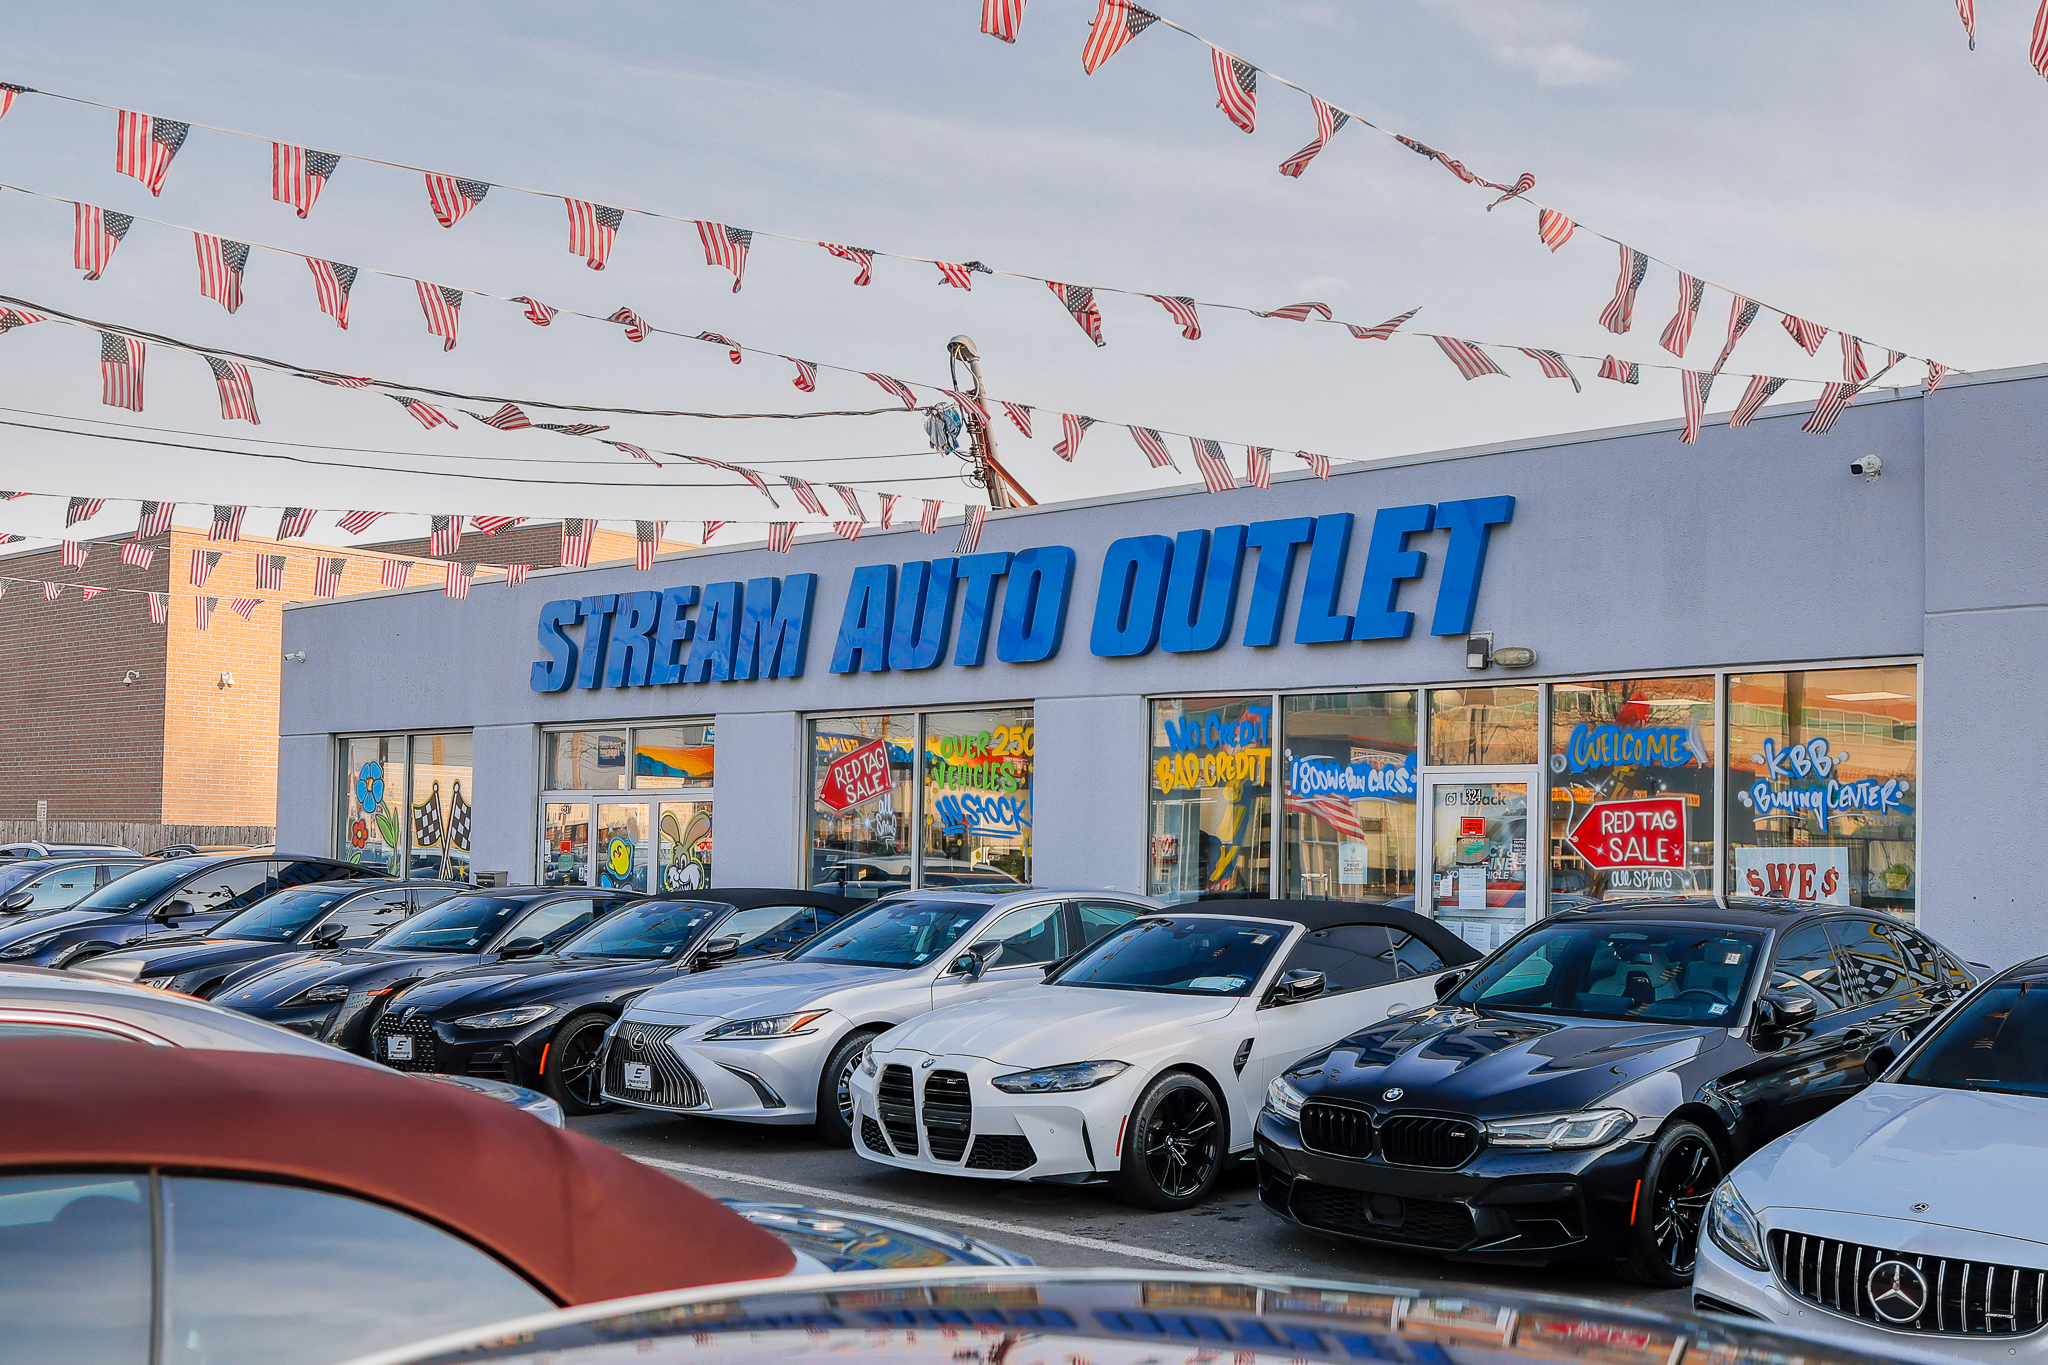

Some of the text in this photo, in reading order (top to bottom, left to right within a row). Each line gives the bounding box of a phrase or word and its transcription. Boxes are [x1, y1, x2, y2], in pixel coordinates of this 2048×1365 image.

[530, 495, 1516, 693] STREAM AUTO OUTLET
[941, 731, 990, 759] OVER
[1165, 706, 1273, 752] NO CREDIT
[1571, 729, 1687, 768] WELCOME
[1764, 738, 1833, 780] KBB
[834, 747, 885, 789] RED TAG
[933, 760, 1017, 793] VEHICLES
[1155, 748, 1272, 794] BAD CREDIT
[936, 795, 964, 827] IN
[1466, 788, 1482, 802] 324
[1601, 809, 1678, 836] RED TAG
[1609, 836, 1670, 863] SALE
